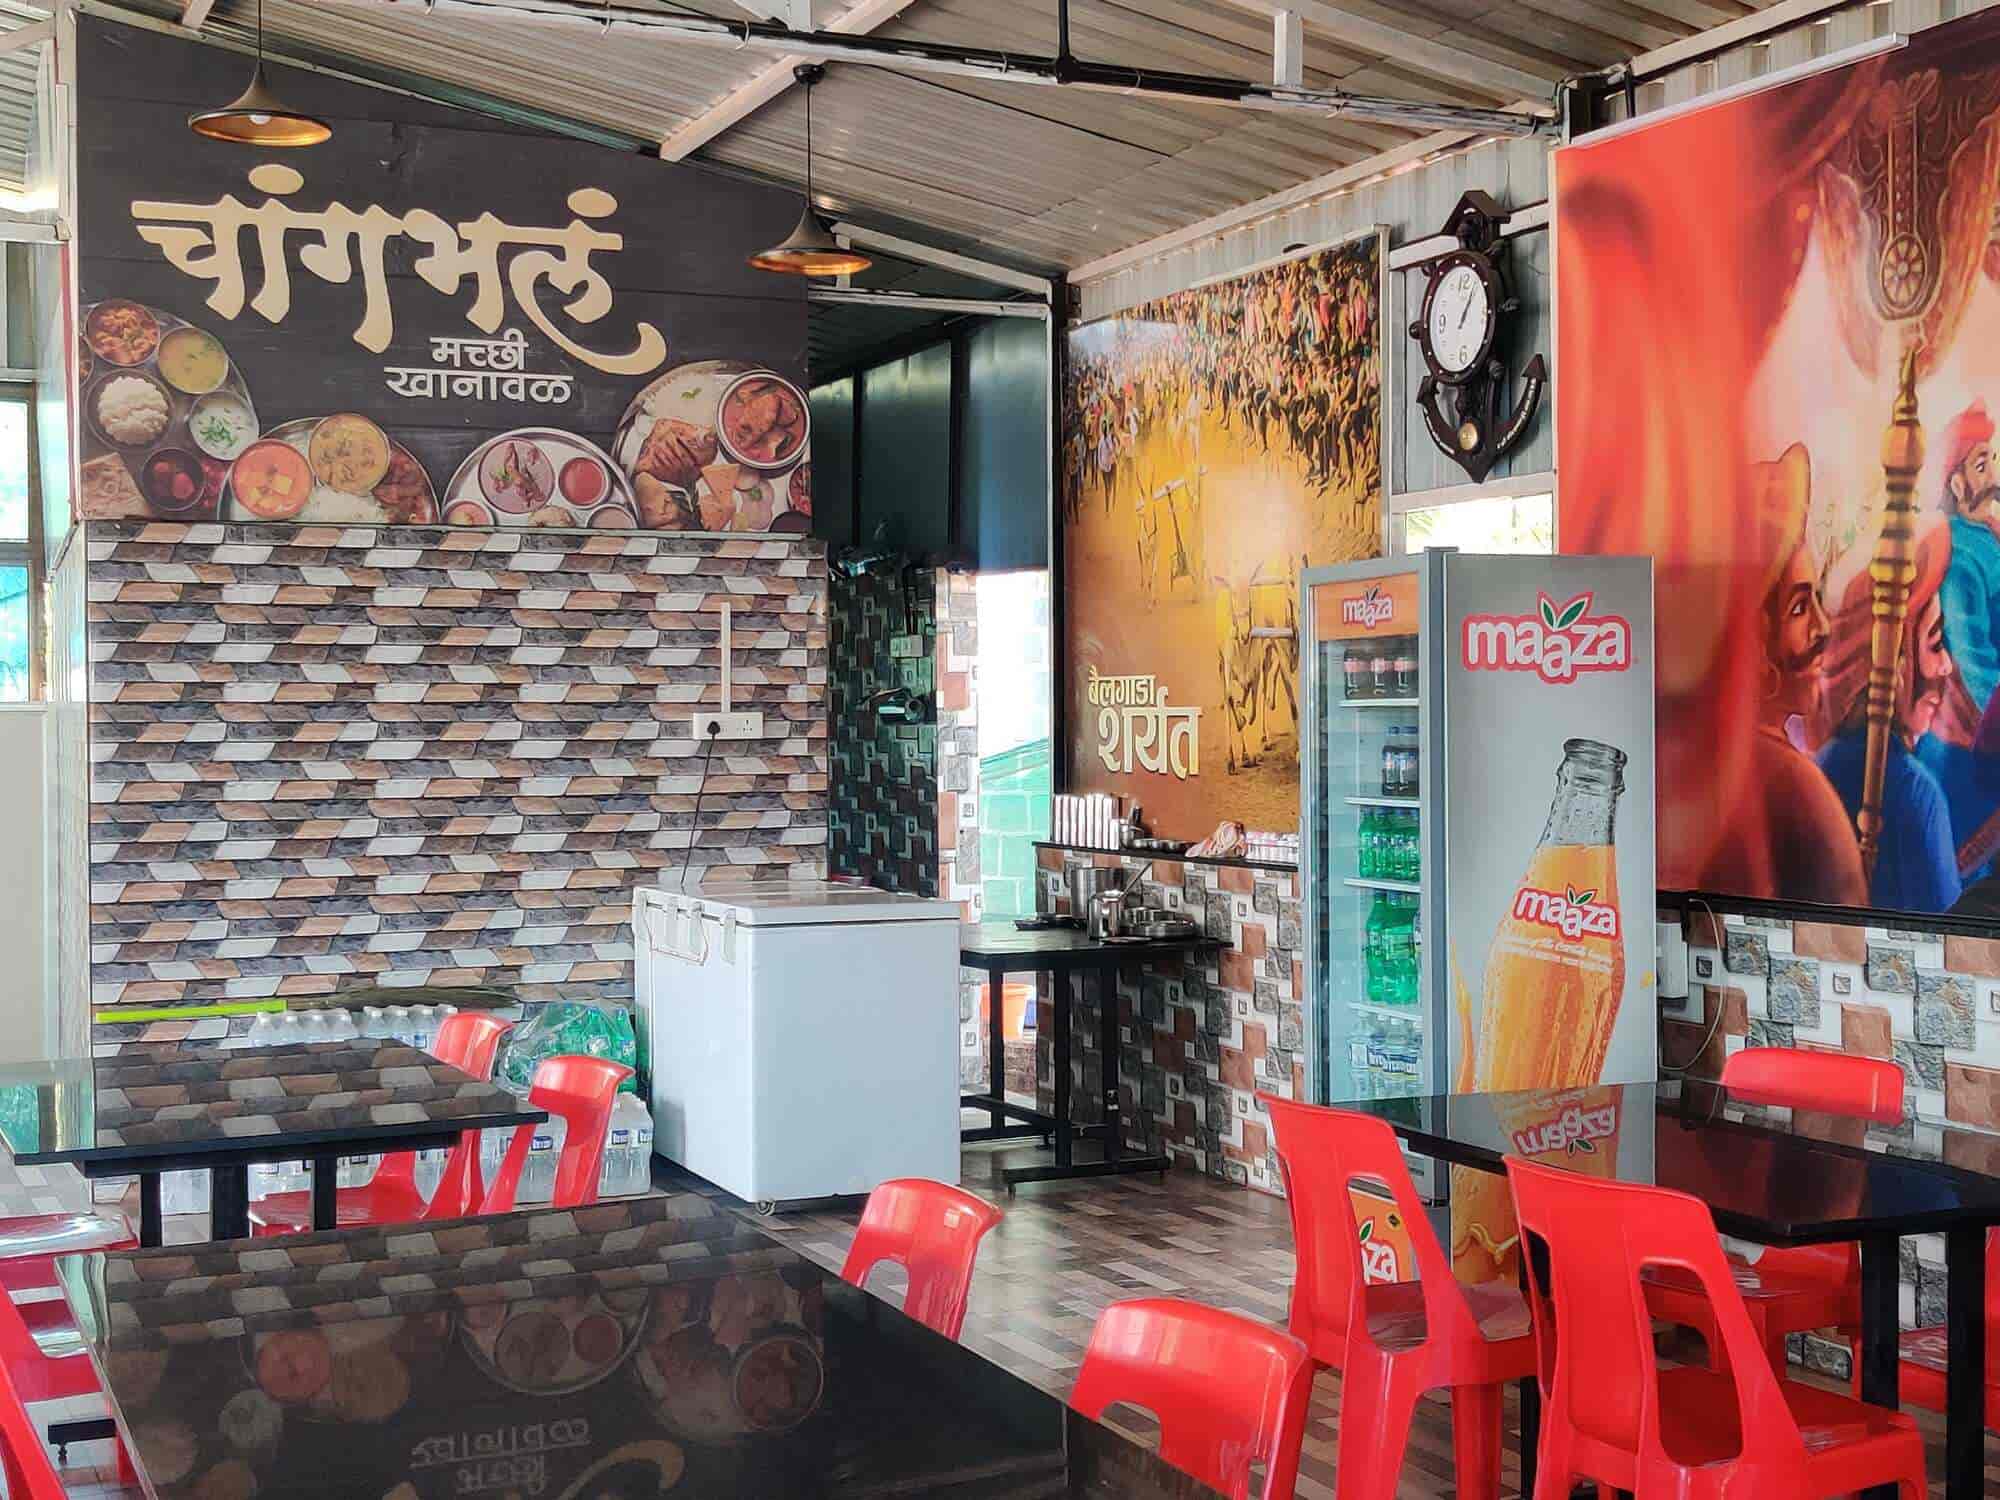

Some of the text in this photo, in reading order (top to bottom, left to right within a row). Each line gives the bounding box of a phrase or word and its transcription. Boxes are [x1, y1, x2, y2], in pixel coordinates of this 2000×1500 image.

[131, 163, 668, 376] चांगभलं
[429, 328, 530, 370] मच्छी
[383, 366, 574, 404] खानावळ
[1343, 595, 1394, 628] maaza
[1466, 618, 1627, 680] maaza
[1098, 686, 1203, 780] शर्यत
[1515, 888, 1618, 939] maaza
